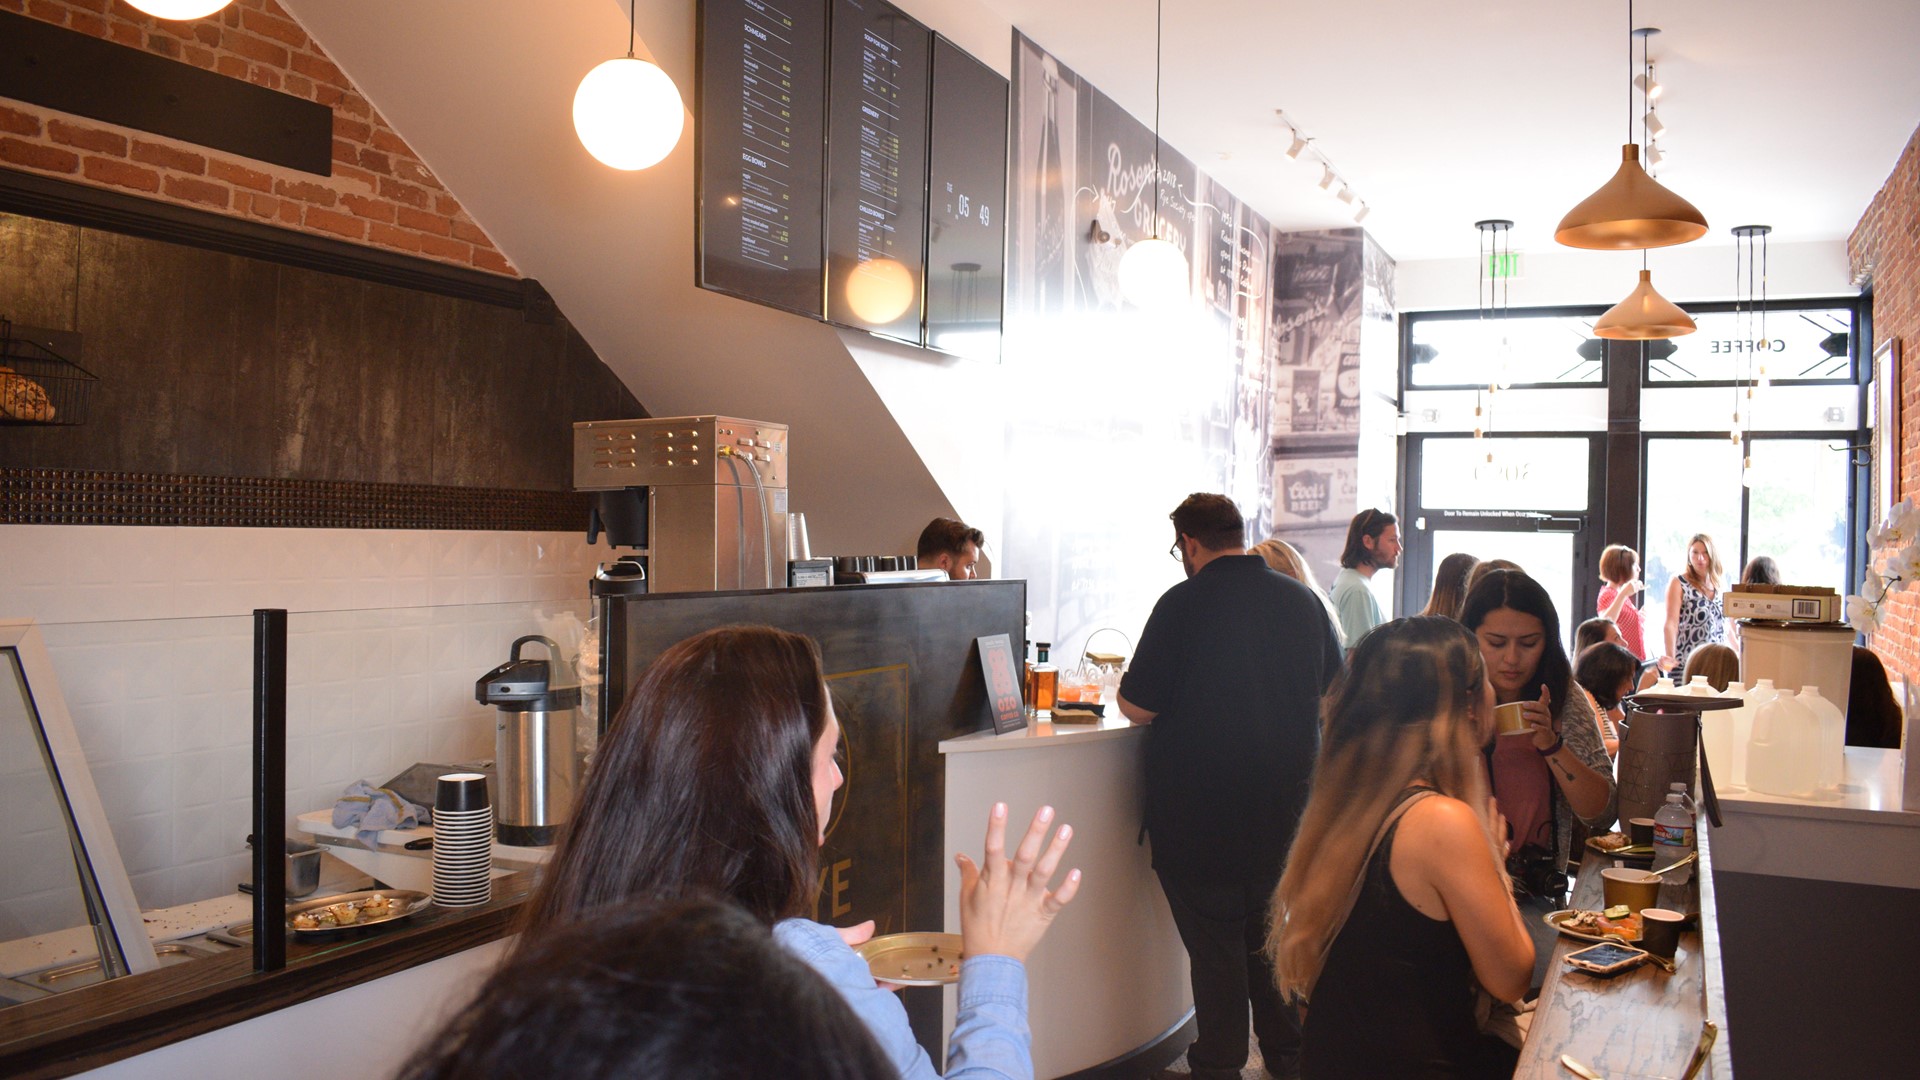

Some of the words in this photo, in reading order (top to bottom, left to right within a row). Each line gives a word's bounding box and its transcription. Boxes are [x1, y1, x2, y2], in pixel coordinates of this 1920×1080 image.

[742, 153, 752, 163] EGG
[751, 156, 767, 168] BOWLS
[958, 193, 970, 218] 05
[979, 204, 990, 227] 49
[1134, 197, 1187, 253] GROCERY
[1489, 253, 1519, 277] EXIT
[1288, 481, 1326, 500] Coors
[1291, 501, 1323, 512] BEER
[1502, 510, 1515, 518] When
[998, 695, 1017, 712] OZO
[811, 859, 851, 921] YE
